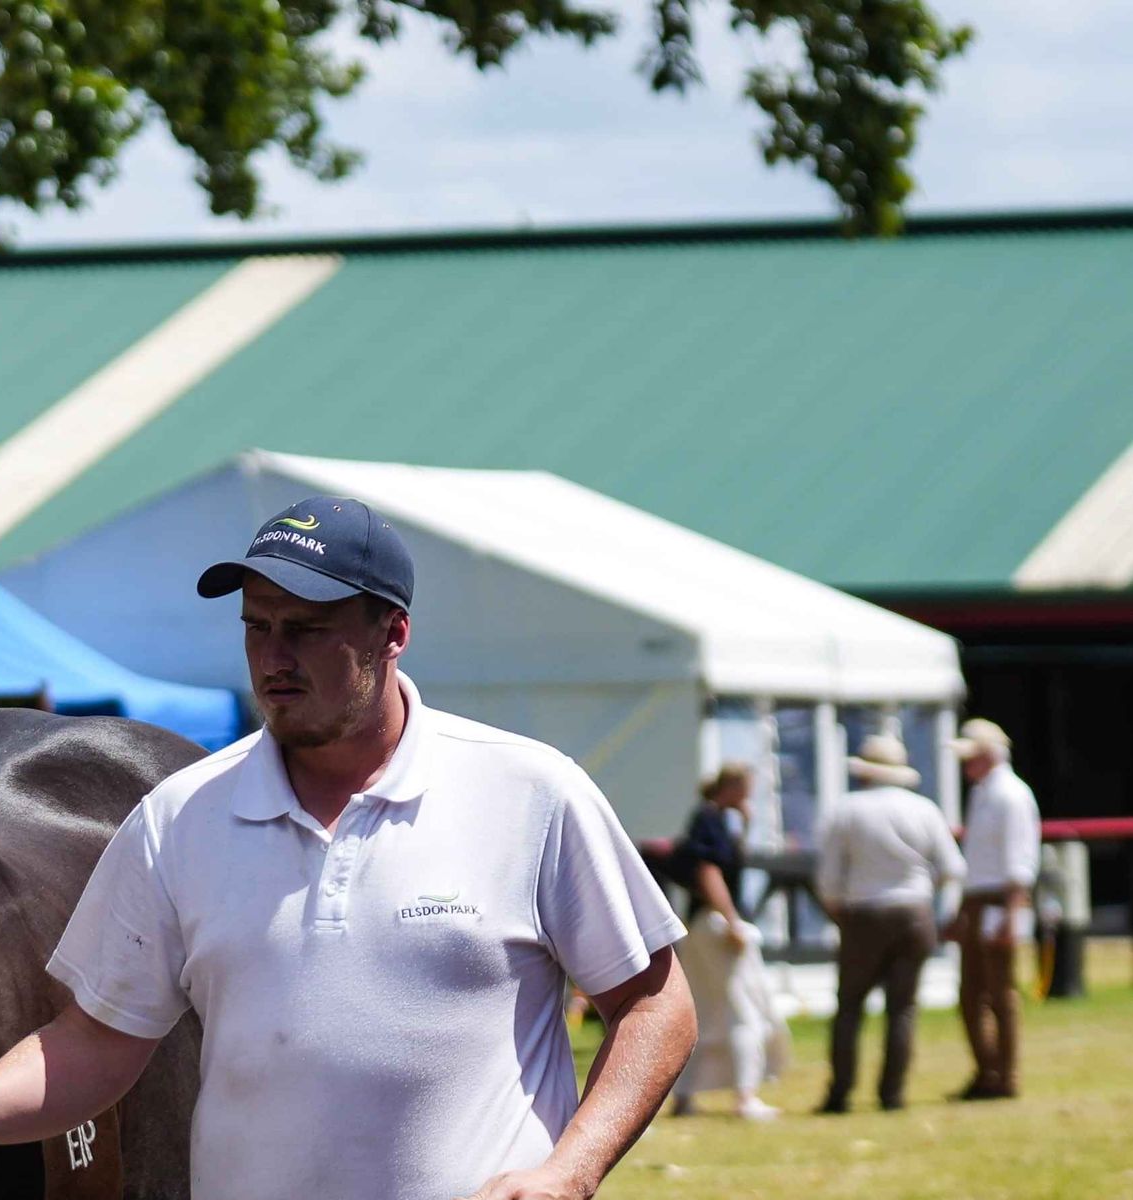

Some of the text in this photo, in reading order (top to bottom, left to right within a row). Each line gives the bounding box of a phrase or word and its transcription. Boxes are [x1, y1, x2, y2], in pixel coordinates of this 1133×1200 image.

[290, 532, 327, 555] PARK
[401, 904, 481, 919] ELSDON PARK
